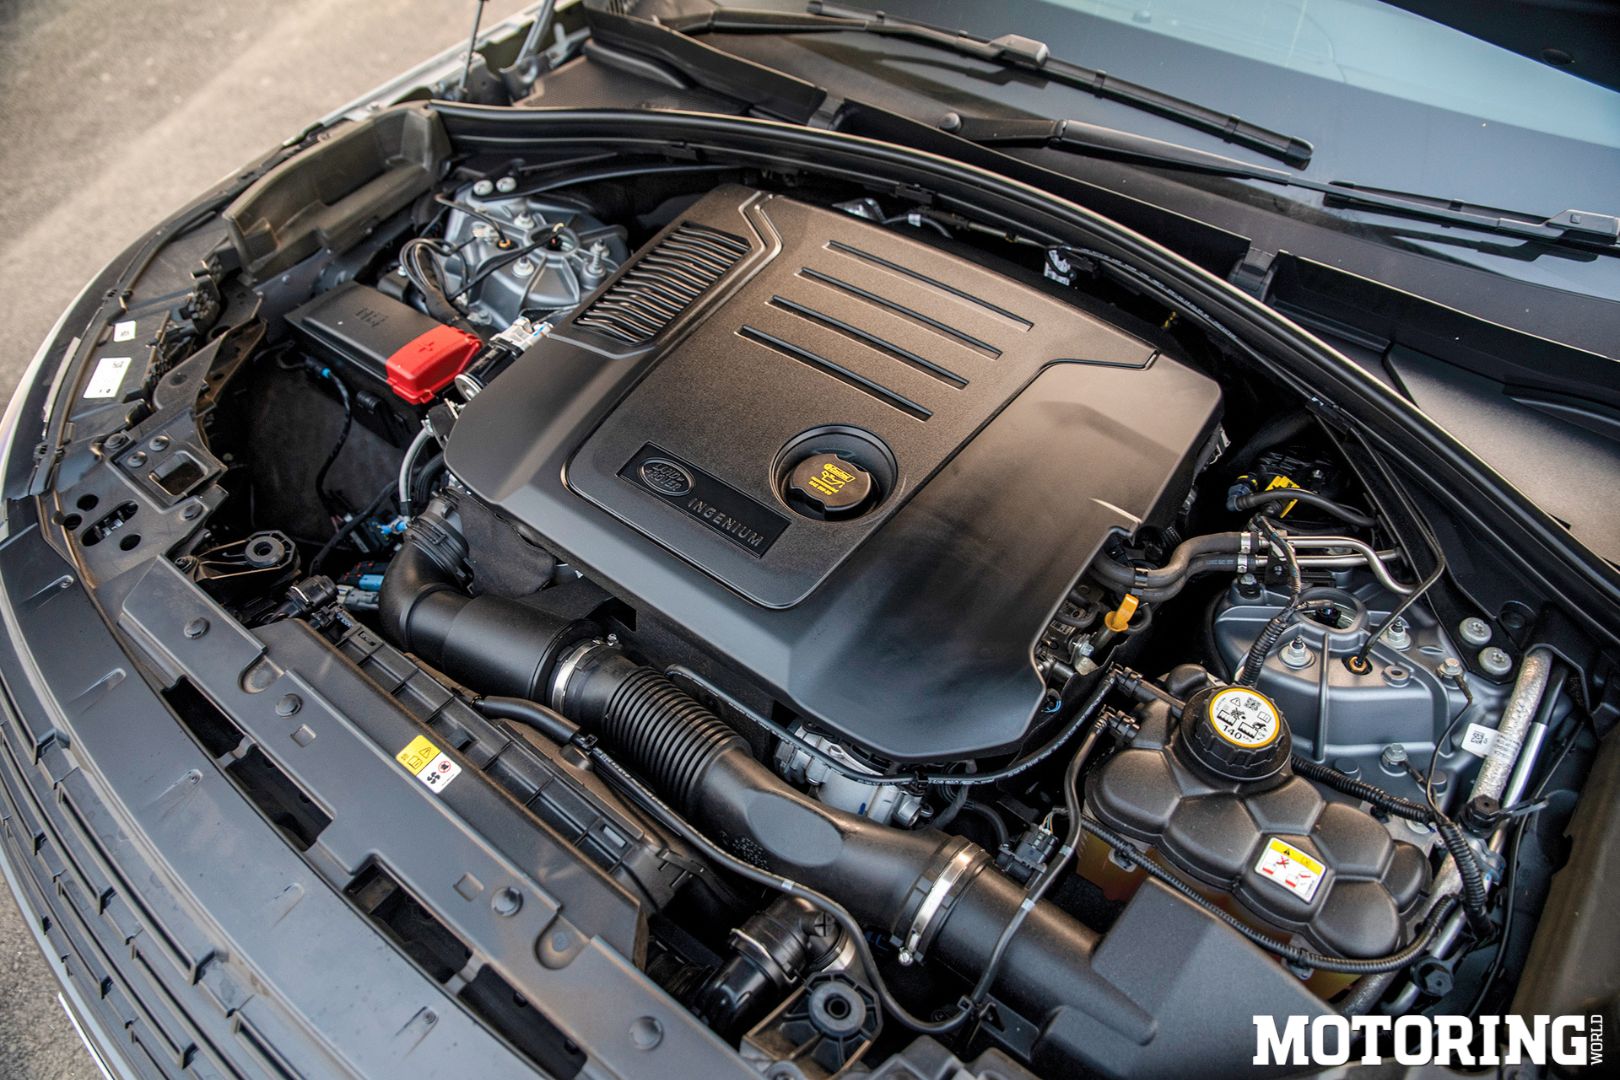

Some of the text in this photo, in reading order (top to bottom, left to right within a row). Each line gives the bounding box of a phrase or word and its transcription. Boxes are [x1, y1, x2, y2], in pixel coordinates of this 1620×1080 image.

[647, 470, 682, 491] ROVER
[652, 463, 682, 480] LAND
[687, 497, 764, 547] INGENIUM
[1223, 724, 1242, 740] 140
